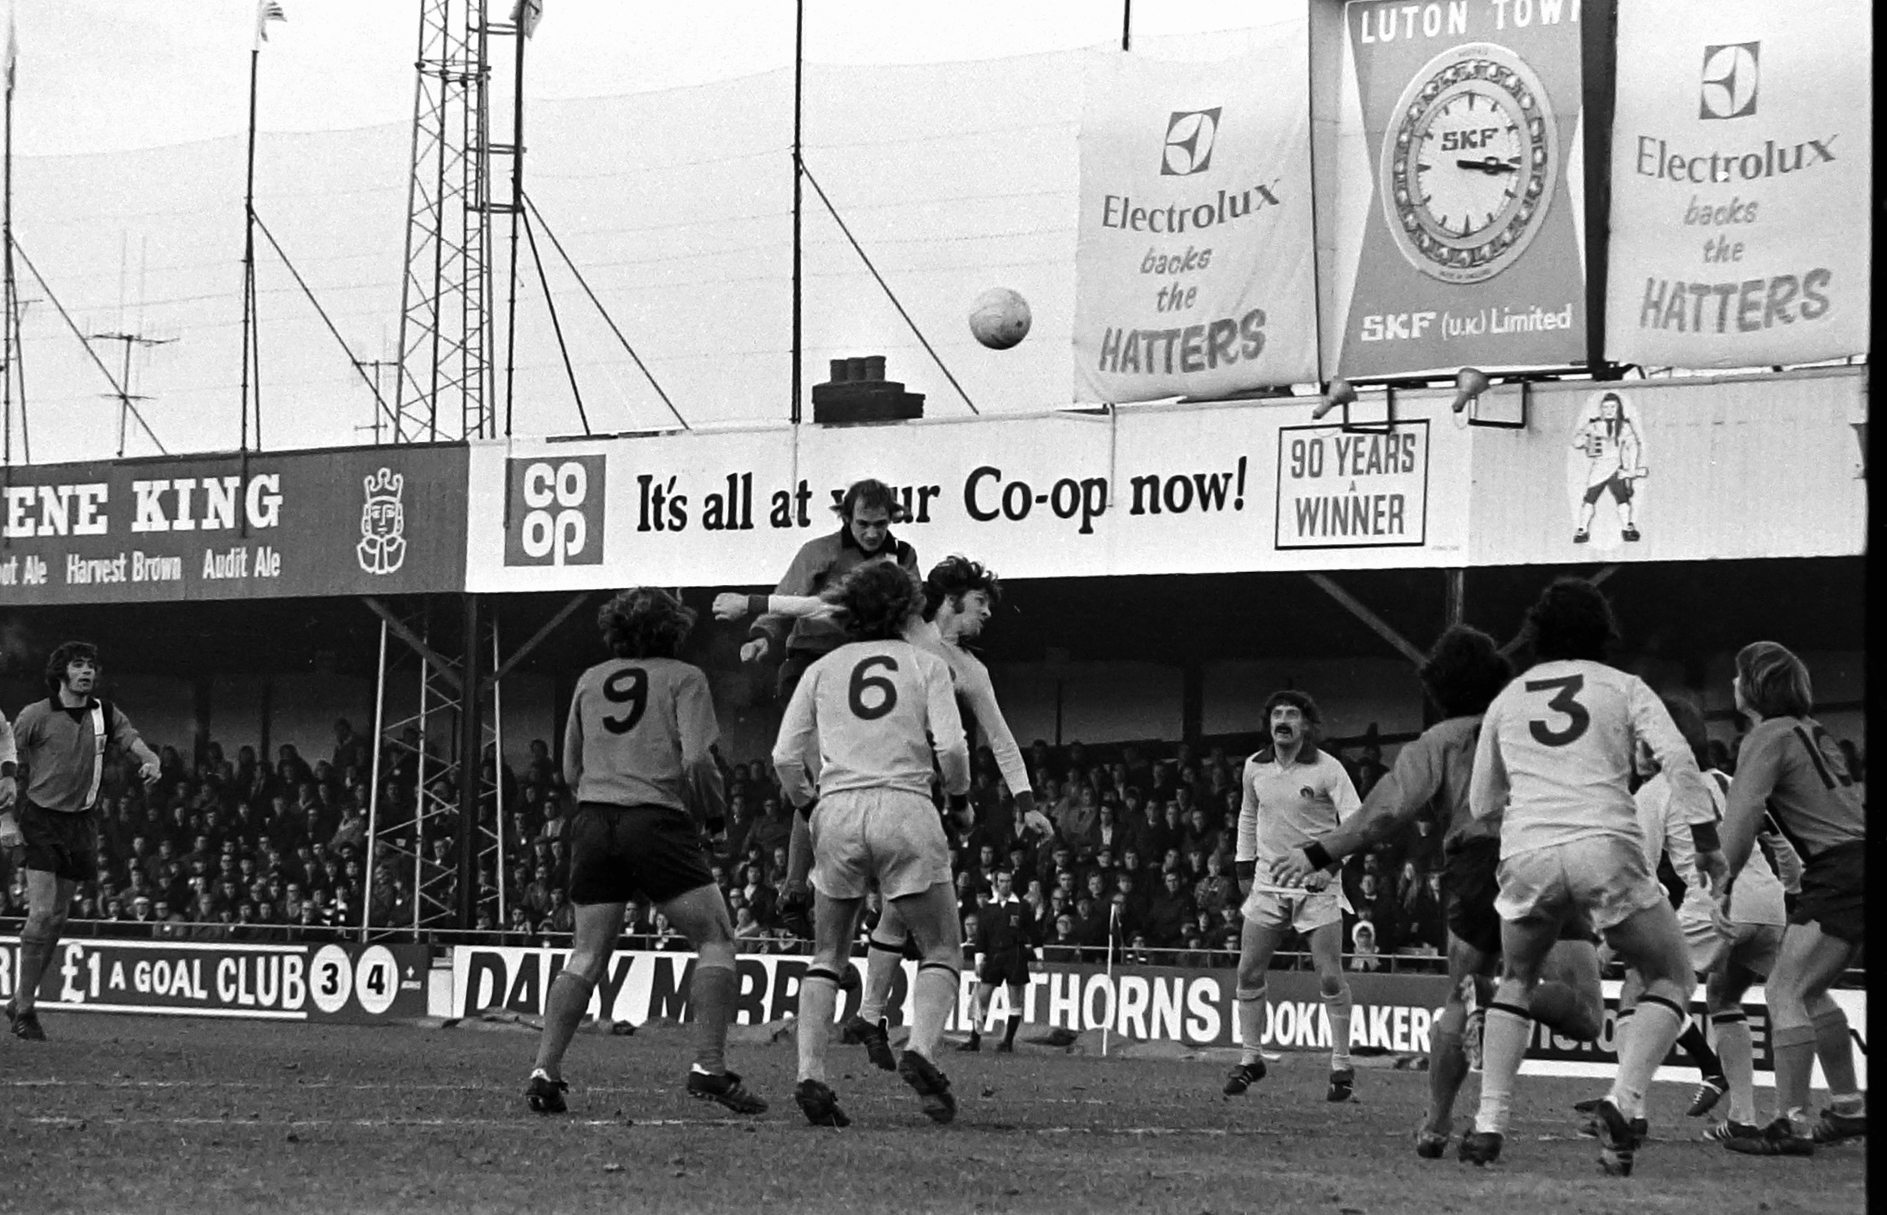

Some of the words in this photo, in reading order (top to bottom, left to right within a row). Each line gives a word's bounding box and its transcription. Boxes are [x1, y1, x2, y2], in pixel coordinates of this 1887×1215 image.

[1361, 0, 1468, 44] LUTON
[1493, 0, 1580, 30] TOW
[1441, 128, 1498, 151] SKF
[1637, 133, 1840, 184] Electrolux
[1102, 178, 1280, 233] Electrolux
[1683, 194, 1759, 226] backs
[1140, 245, 1213, 275] backs
[1703, 235, 1745, 263] the
[1156, 281, 1198, 313] the
[1640, 267, 1833, 333] HATTERS
[1099, 308, 1267, 374] HATTERS
[1361, 311, 1437, 342] SKF
[1491, 303, 1572, 333] Limited
[1291, 438, 1324, 478] 90
[1335, 433, 1416, 477] YEARS
[2, 483, 109, 538] ENE
[131, 473, 283, 533] KING
[637, 474, 688, 532] It's
[702, 472, 754, 530] all
[770, 479, 812, 528] at
[829, 484, 941, 524] ur
[964, 465, 1109, 534] Co-op
[1130, 455, 1248, 516] now!
[1349, 479, 1357, 493] A
[1295, 493, 1405, 537] WINNER
[22, 554, 48, 585] Ale
[66, 552, 127, 584] Harvest
[131, 550, 182, 582] Brown
[202, 547, 248, 579] Audit
[253, 546, 281, 578] Ale
[602, 667, 648, 735] 9
[848, 655, 898, 720] 6
[1525, 674, 1590, 747] 3
[60, 943, 101, 1003] £1
[109, 960, 126, 991] A
[134, 958, 208, 999] GOAL
[217, 954, 306, 1010] CLUB
[321, 962, 339, 995] 3
[367, 964, 385, 995] 4
[464, 951, 635, 1020] DAY
[944, 970, 1221, 1043] EATHORNS
